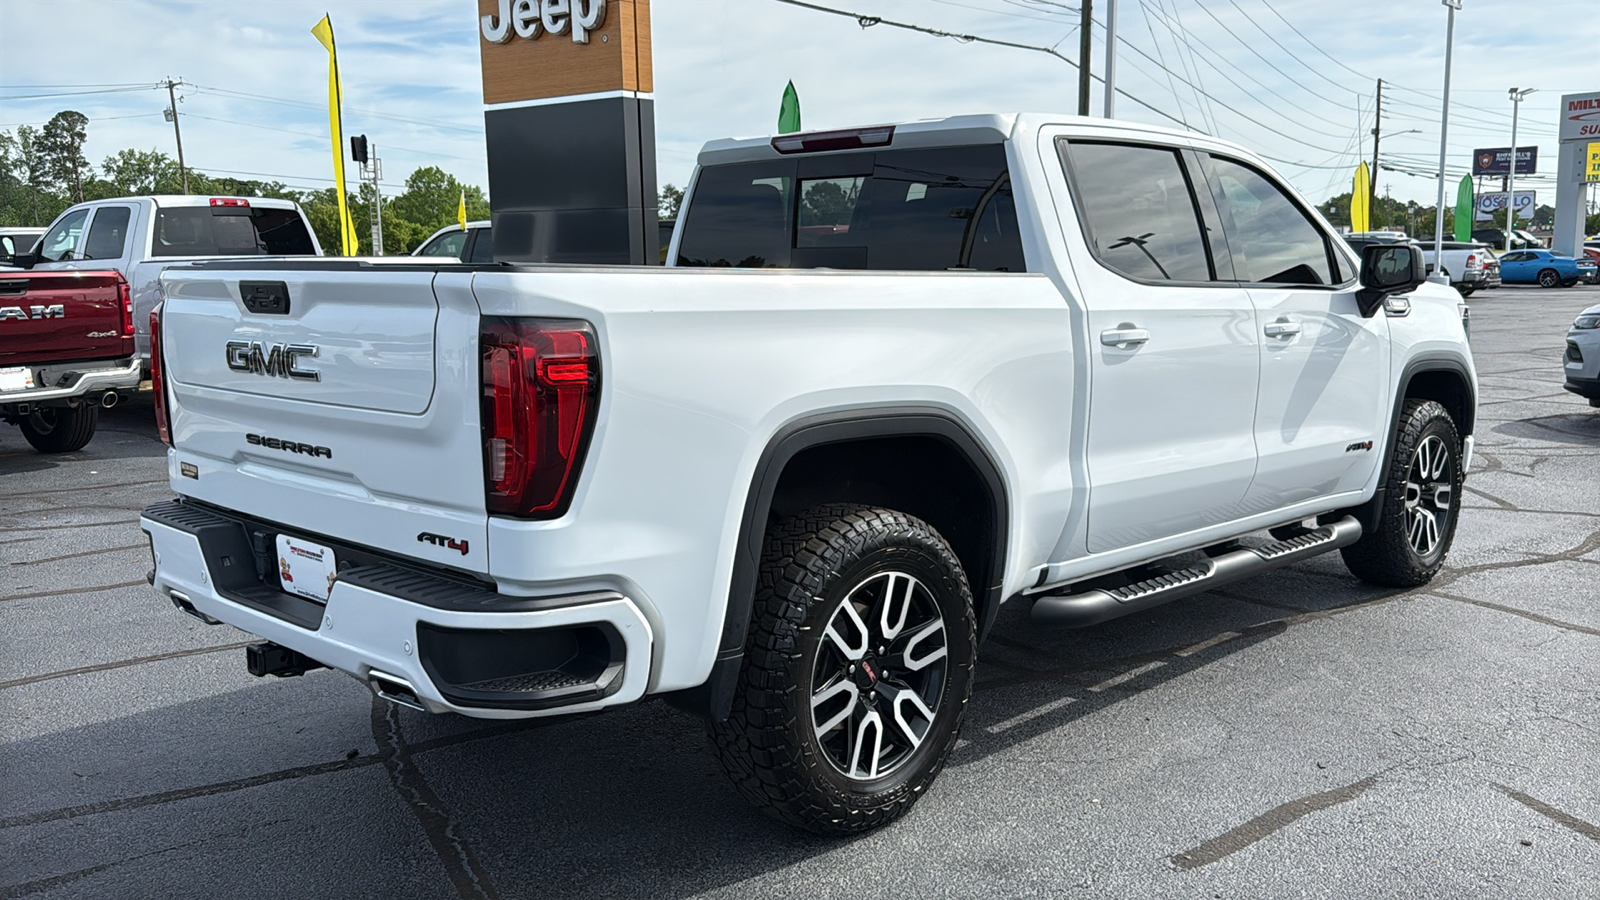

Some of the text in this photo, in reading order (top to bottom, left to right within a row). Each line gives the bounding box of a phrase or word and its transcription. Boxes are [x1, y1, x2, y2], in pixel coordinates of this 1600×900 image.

[481, 0, 606, 44] Jeep
[1473, 196, 1531, 208] HOSTLO
[226, 340, 321, 382] GMC
[246, 433, 332, 459] SIERRA
[417, 531, 469, 556] AT4
